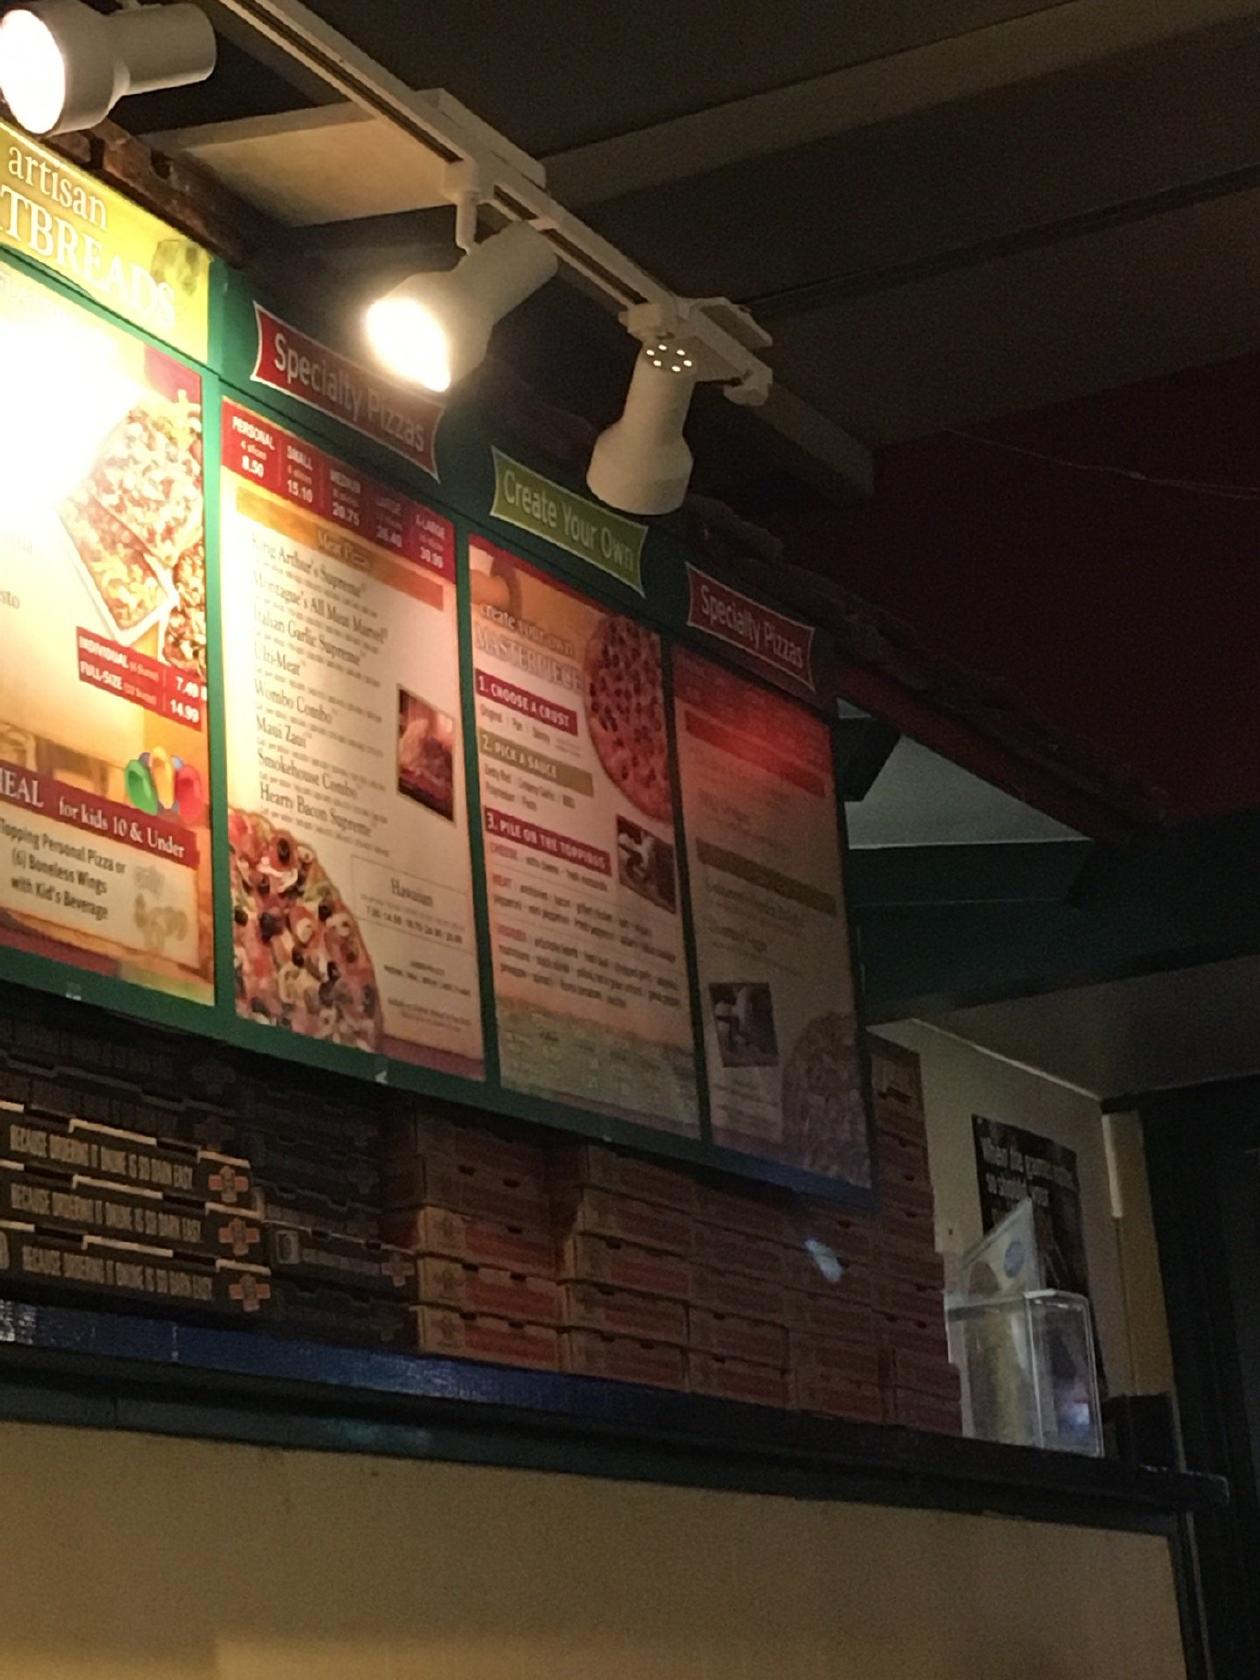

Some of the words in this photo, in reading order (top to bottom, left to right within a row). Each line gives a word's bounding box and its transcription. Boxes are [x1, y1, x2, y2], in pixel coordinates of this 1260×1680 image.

[8, 146, 108, 231] artisan
[273, 332, 363, 422] Specialty
[367, 388, 425, 453] Pizzas
[503, 470, 557, 528] Create
[562, 501, 599, 551] Your
[600, 527, 634, 572] Own
[700, 584, 761, 650] Specialty
[764, 621, 804, 670] Pizzas
[490, 683, 529, 712] CHOOSE
[538, 704, 571, 728] CRUST
[43, 832, 85, 861] Personal
[88, 847, 114, 872] Pizza
[59, 796, 79, 819] for
[81, 805, 108, 831] kids
[113, 815, 127, 837] 10
[130, 824, 144, 844] &
[147, 827, 186, 858] Under
[11, 875, 33, 894] with
[77, 869, 108, 896] Wings
